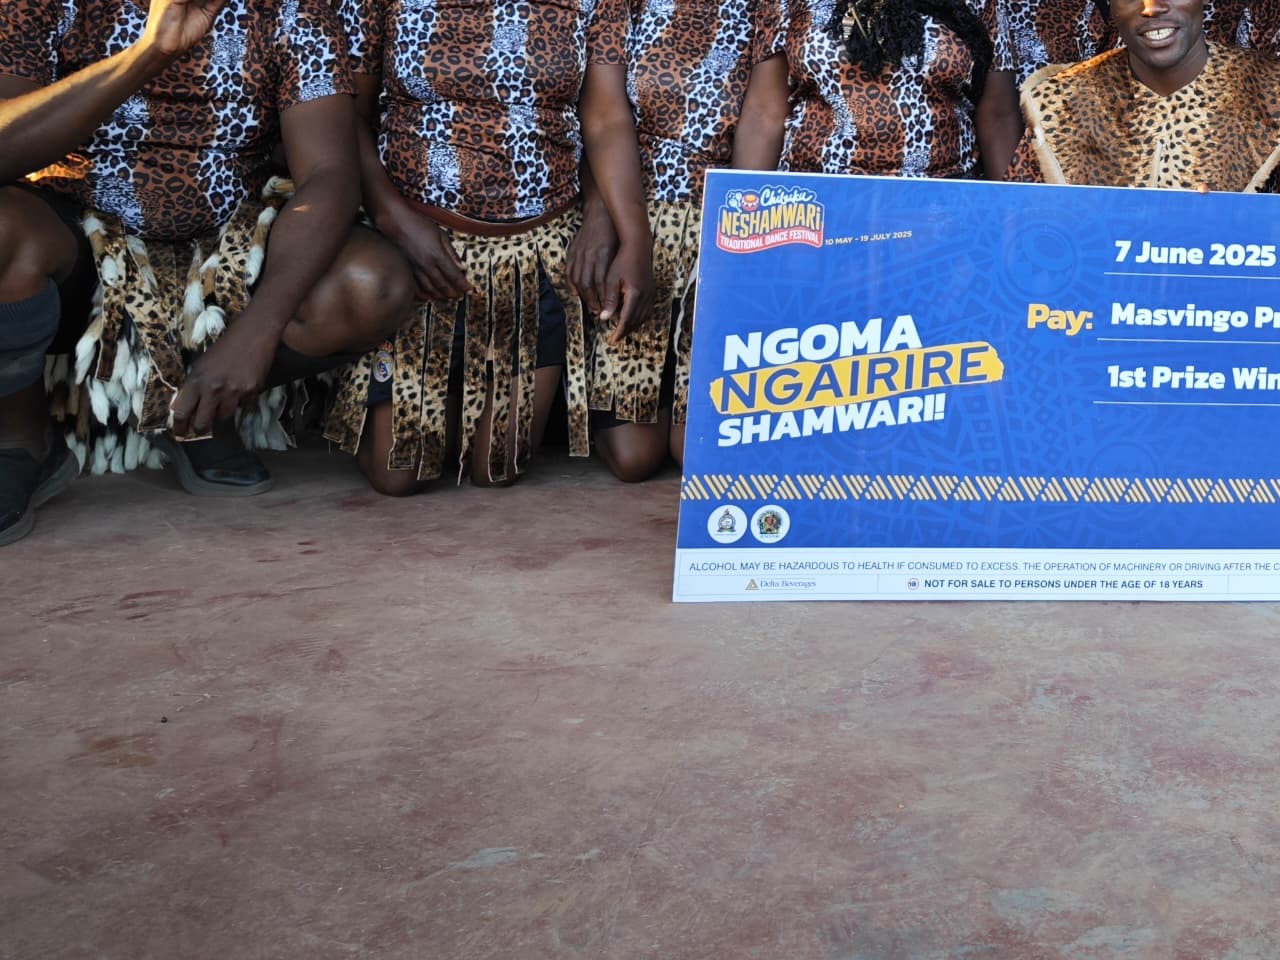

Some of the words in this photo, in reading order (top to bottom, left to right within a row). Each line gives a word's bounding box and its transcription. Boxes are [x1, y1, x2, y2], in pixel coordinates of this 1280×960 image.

[760, 187, 813, 207] Chibuku
[720, 234, 764, 250] TRADITIONAL
[765, 230, 788, 246] DANCE
[789, 229, 820, 245] FESTIVAL
[835, 237, 853, 245] MAY
[860, 235, 869, 243] 19
[870, 233, 891, 241] JULY
[892, 230, 913, 240] 2025
[1114, 240, 1132, 262] 7
[1135, 240, 1204, 265] June
[1209, 243, 1277, 267] 2025
[1027, 302, 1094, 336] Pay:
[1111, 302, 1249, 332] Masvingo
[723, 314, 923, 372] NGOMA
[720, 345, 990, 413] NGAIRIRE
[1107, 365, 1147, 388] 1st
[1152, 366, 1226, 390] Prize
[717, 393, 947, 447] SHAMWARI!!
[689, 562, 737, 571] ALCOHOL
[740, 562, 761, 570] MAY
[763, 562, 776, 570] BE
[779, 561, 839, 570] HAZARDOUS
[840, 561, 855, 570] TO
[857, 561, 894, 570] HEALTH
[897, 561, 905, 570] IF
[907, 561, 963, 570] CONSUMED
[966, 562, 979, 570] TO
[1023, 562, 1041, 571] THE
[1043, 562, 1097, 571] OPERATION
[1099, 562, 1112, 571] OF
[1113, 562, 1166, 571] MACHINERY
[1169, 562, 1182, 571] OR
[1185, 562, 1220, 571] DRIVING
[1223, 562, 1252, 571] AFTER
[1254, 562, 1271, 571] THE
[924, 580, 945, 588] NOT
[948, 580, 968, 588] FOR
[970, 580, 996, 588] SALE
[1000, 580, 1011, 588] TO
[1014, 580, 1061, 588] PERSONS
[1064, 580, 1097, 588] UNDER
[1143, 580, 1157, 588] OF
[1160, 580, 1170, 588] 18
[1172, 580, 1204, 588] YEARS
